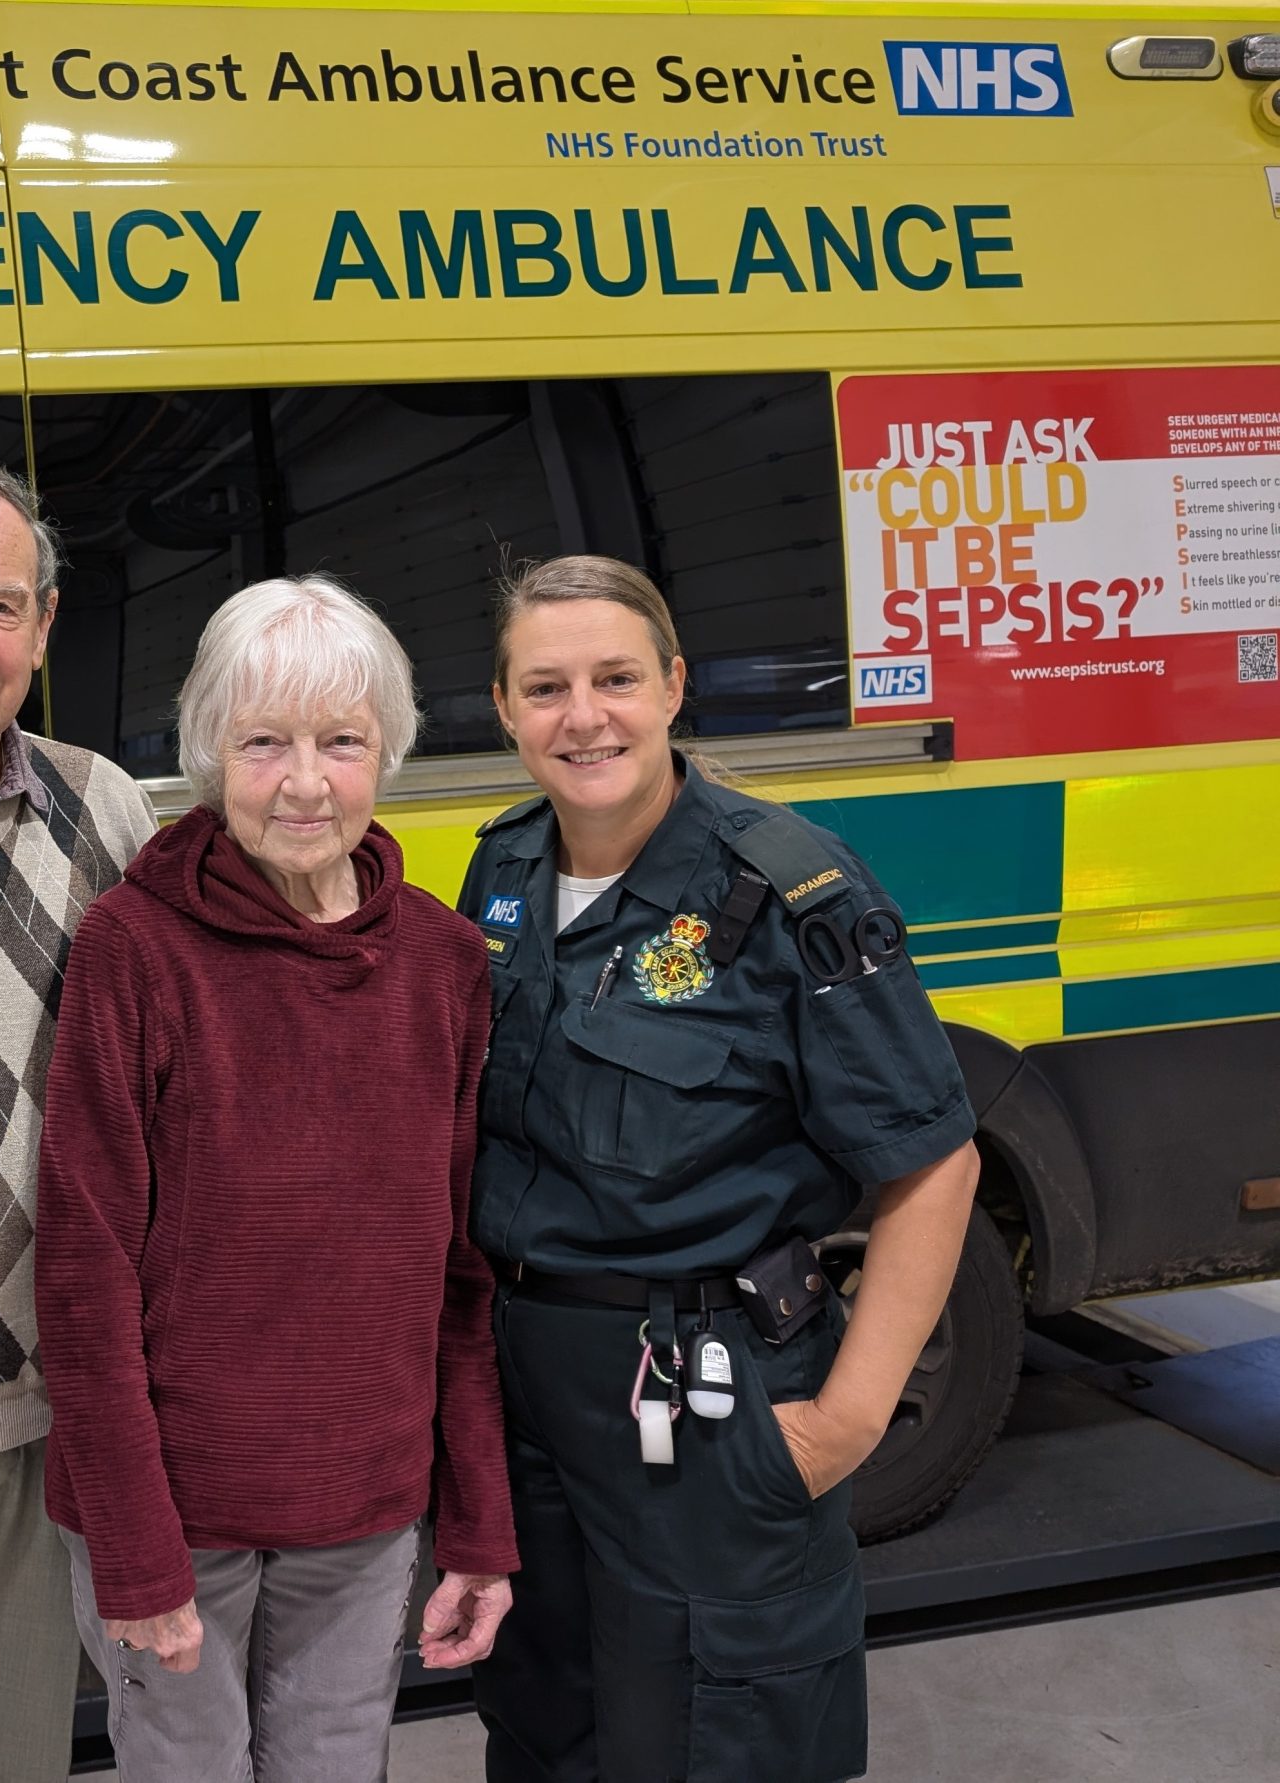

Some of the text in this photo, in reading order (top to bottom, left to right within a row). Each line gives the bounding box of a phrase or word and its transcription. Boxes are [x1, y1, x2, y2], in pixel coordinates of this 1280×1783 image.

[51, 48, 248, 102] Coast
[268, 48, 636, 104] Ambulance
[656, 53, 876, 104] Service
[901, 47, 1060, 112] NHS
[546, 131, 888, 159] NHS Foundation Trust
[312, 203, 1024, 301] AMBULANCE
[1168, 415, 1195, 427] SEEK
[1197, 413, 1238, 425] URGENT
[876, 417, 1100, 469] JUST ASK
[1169, 428, 1219, 440] SOMEONE
[1220, 427, 1247, 439] WITH
[1249, 427, 1264, 438] AN
[1171, 442, 1223, 454] DEVELOPS
[1225, 441, 1245, 453] ANY
[1247, 440, 1261, 451] OF
[1221, 476, 1258, 491] speech
[1260, 478, 1271, 487] or
[1227, 500, 1275, 514] shivering
[1226, 527, 1238, 537] no
[1241, 524, 1268, 536] urine
[882, 523, 1038, 591] IT BE
[1198, 574, 1224, 587] feels
[1227, 573, 1246, 585] like
[1212, 597, 1251, 611] mottled
[1254, 599, 1266, 608] or
[1011, 659, 1166, 680] www.sepsistrust.org
[862, 667, 924, 697] NHS
[784, 868, 843, 903] PARAMEDIC
[486, 899, 520, 923] NHS
